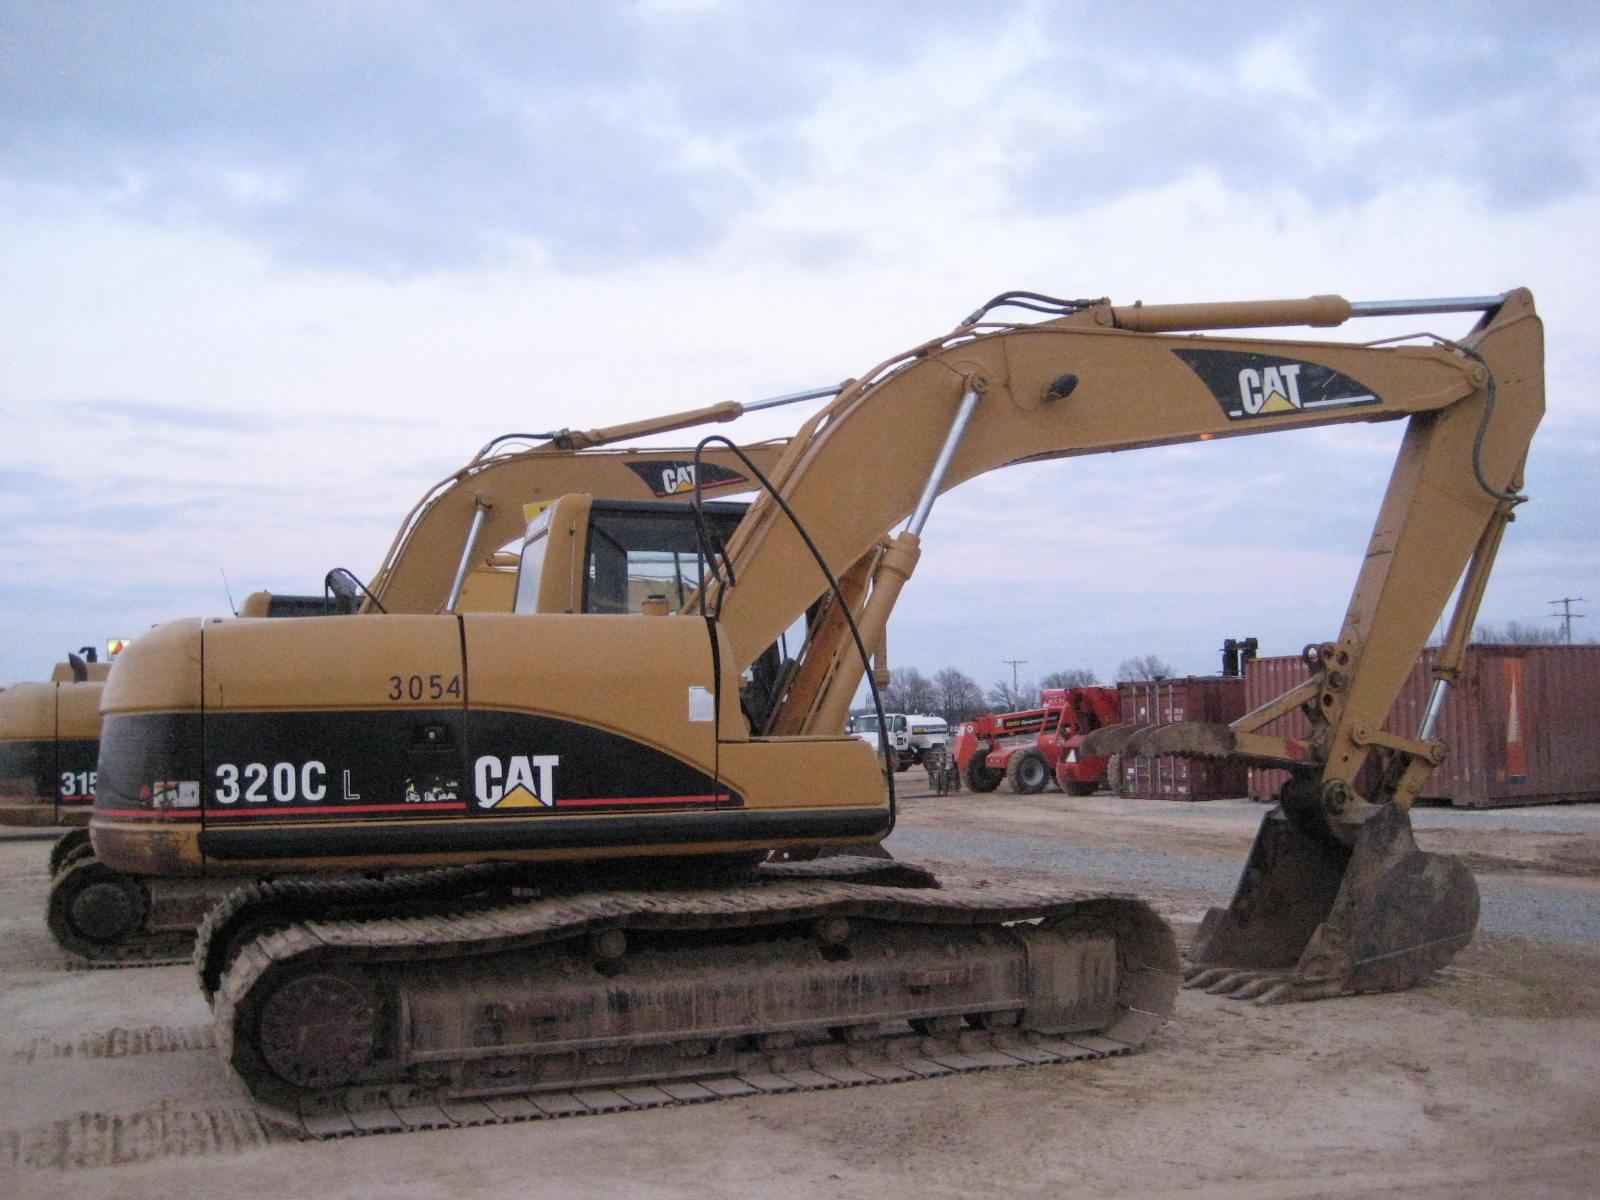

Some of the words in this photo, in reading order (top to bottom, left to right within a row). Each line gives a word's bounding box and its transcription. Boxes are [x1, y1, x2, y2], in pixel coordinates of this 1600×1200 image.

[1239, 365, 1301, 414] CAT
[388, 674, 460, 700] 3054
[216, 761, 327, 804] 320C
[343, 769, 361, 800] L
[474, 754, 559, 808] CAT
